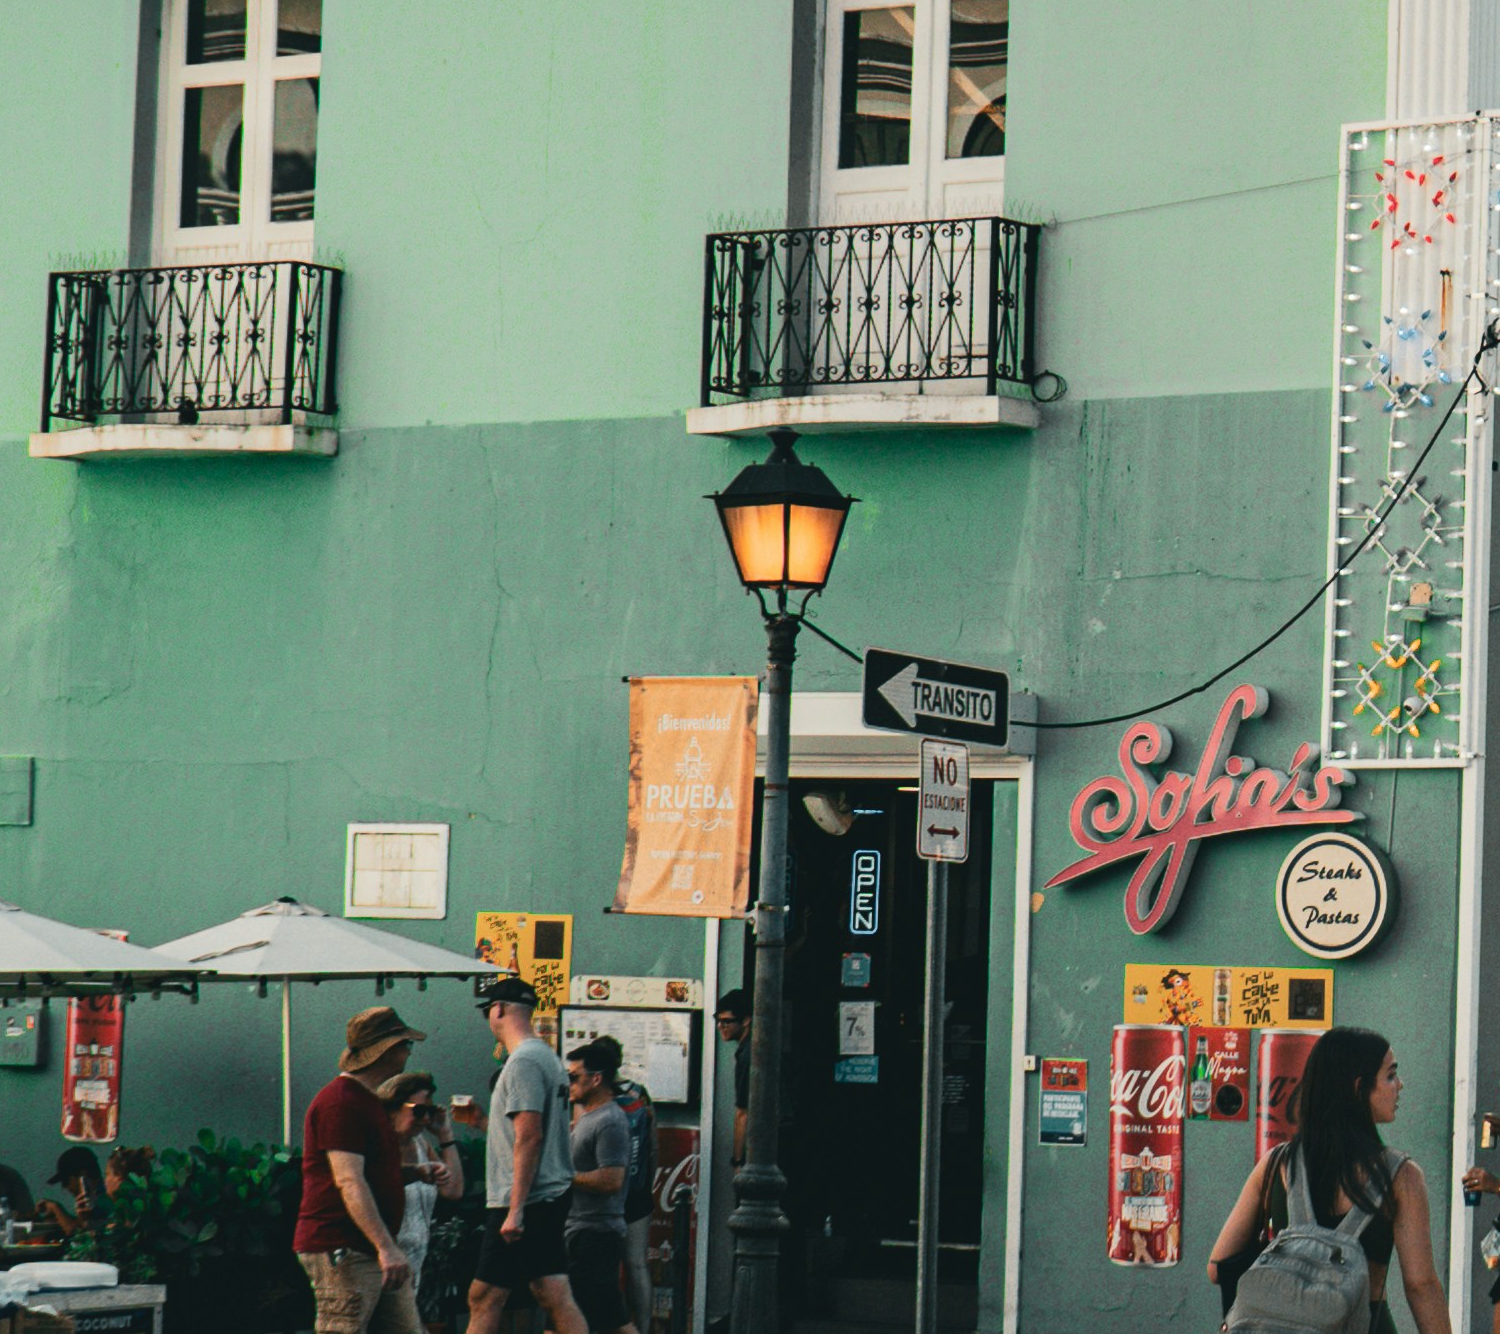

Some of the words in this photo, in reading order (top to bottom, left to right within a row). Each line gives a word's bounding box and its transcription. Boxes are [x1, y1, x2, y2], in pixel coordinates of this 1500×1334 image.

[911, 680, 993, 722] TRANSITO
[933, 755, 959, 787] NO
[646, 784, 735, 809] PRUEBA
[1044, 683, 1354, 935] Sofia's
[1297, 860, 1362, 883] Steaks
[854, 854, 875, 931] OPEN
[1323, 887, 1338, 903] &
[1302, 905, 1360, 929] Pastas
[846, 1017, 867, 1037] 7%
[75, 1314, 132, 1332] COCONUT
